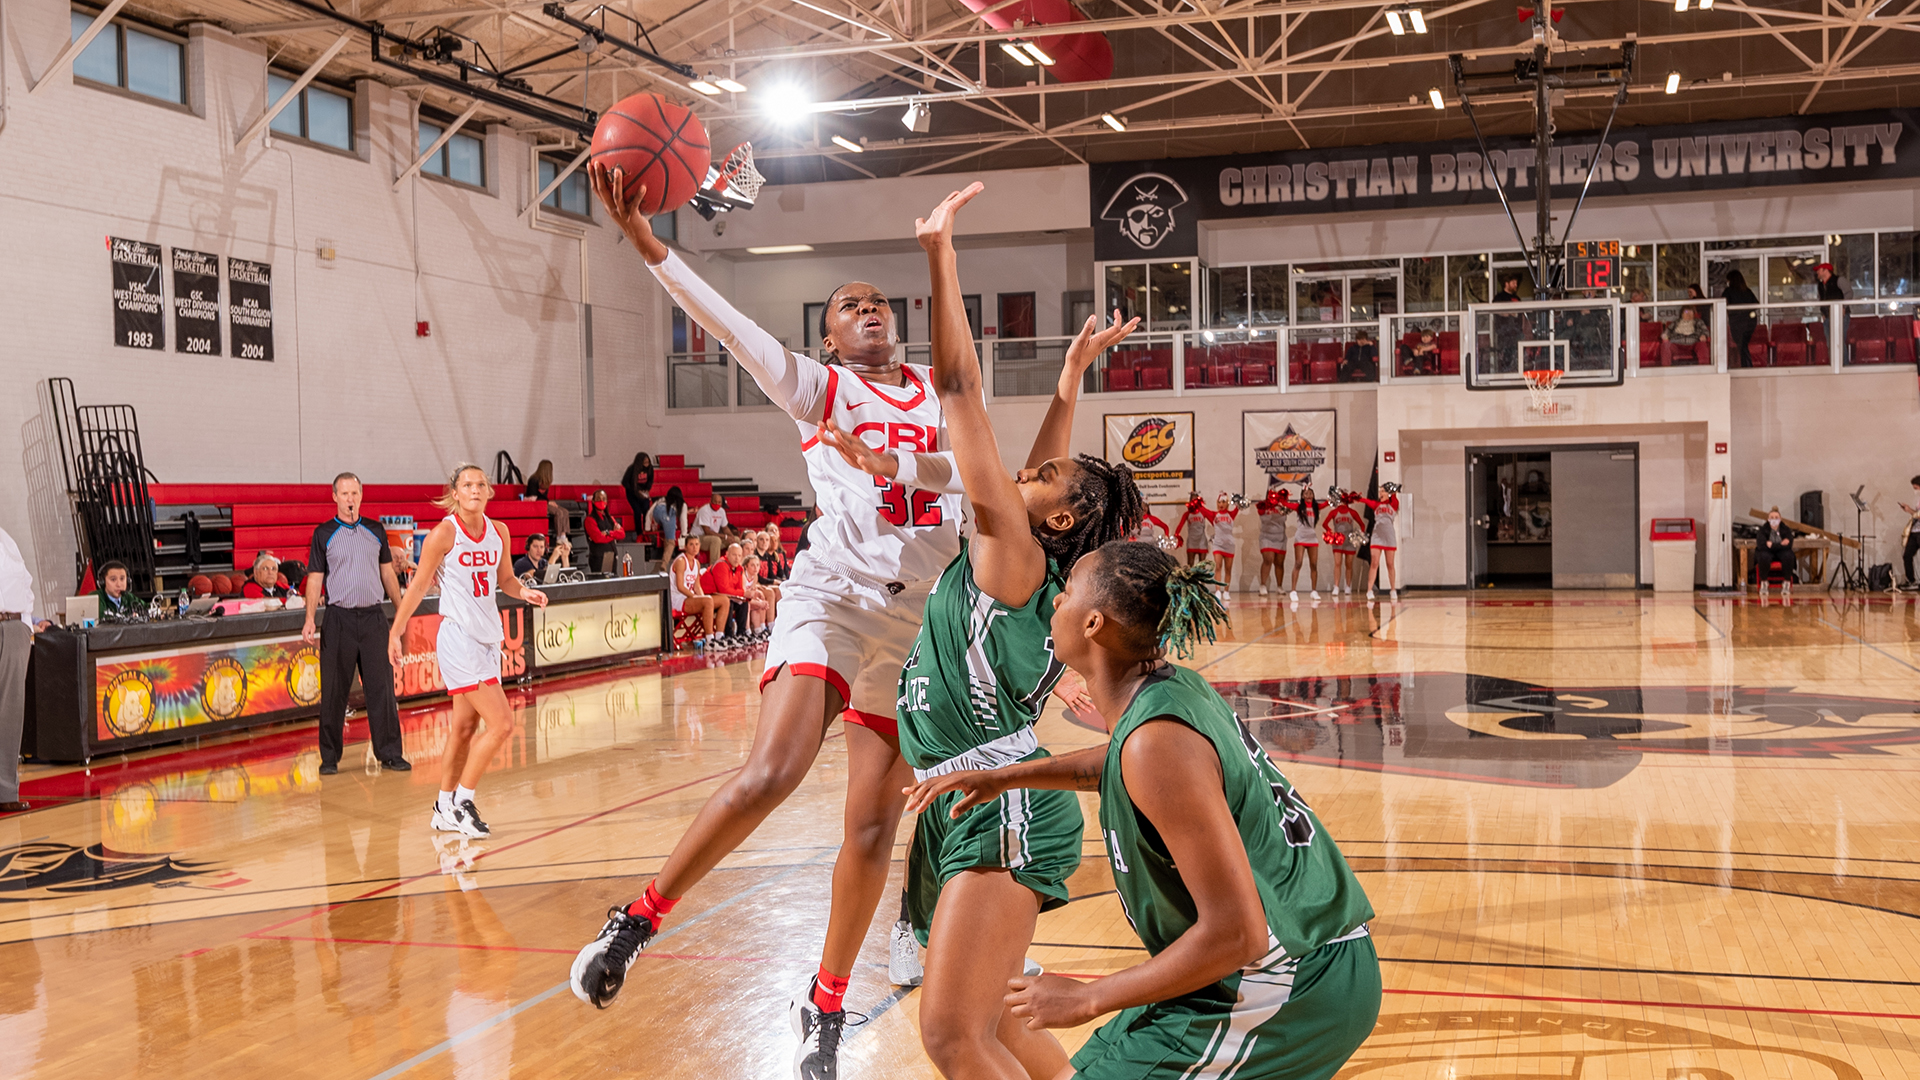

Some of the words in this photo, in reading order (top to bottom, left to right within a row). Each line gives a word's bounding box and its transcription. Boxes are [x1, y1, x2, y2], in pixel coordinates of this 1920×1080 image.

[1219, 156, 1418, 206] CHRISTIAN
[1652, 122, 1903, 180] UNIVERSITY
[113, 250, 159, 266] BASKETBALL
[174, 259, 217, 276] BASKETBALL
[1586, 260, 1610, 287] 12
[230, 269, 269, 284] BASKETBALL
[129, 281, 146, 293] VSAC
[190, 290, 203, 300] GSC
[114, 289, 132, 300] WEST
[133, 292, 161, 304] DIVISION
[175, 297, 191, 308] WEST
[192, 300, 219, 312] DIVISION
[243, 298, 259, 308] NCAA
[119, 300, 158, 314] CHAMPIONS
[179, 308, 215, 320] CHAMPIONS
[230, 305, 249, 315] SOUTH
[250, 307, 271, 318] REGION
[232, 314, 270, 328] TOURNAMENT
[127, 331, 153, 347] 1983
[186, 337, 211, 353] 2004
[241, 343, 264, 359] 2004
[1122, 420, 1175, 461] GSC
[1257, 451, 1295, 459] RAYMOND
[1133, 471, 1184, 480] .gscsports.org
[873, 474, 942, 526] 32
[458, 550, 497, 567] CBU
[472, 571, 489, 597] 15
[203, 658, 230, 683] CENTRAL
[106, 671, 136, 698] CENTRAL
